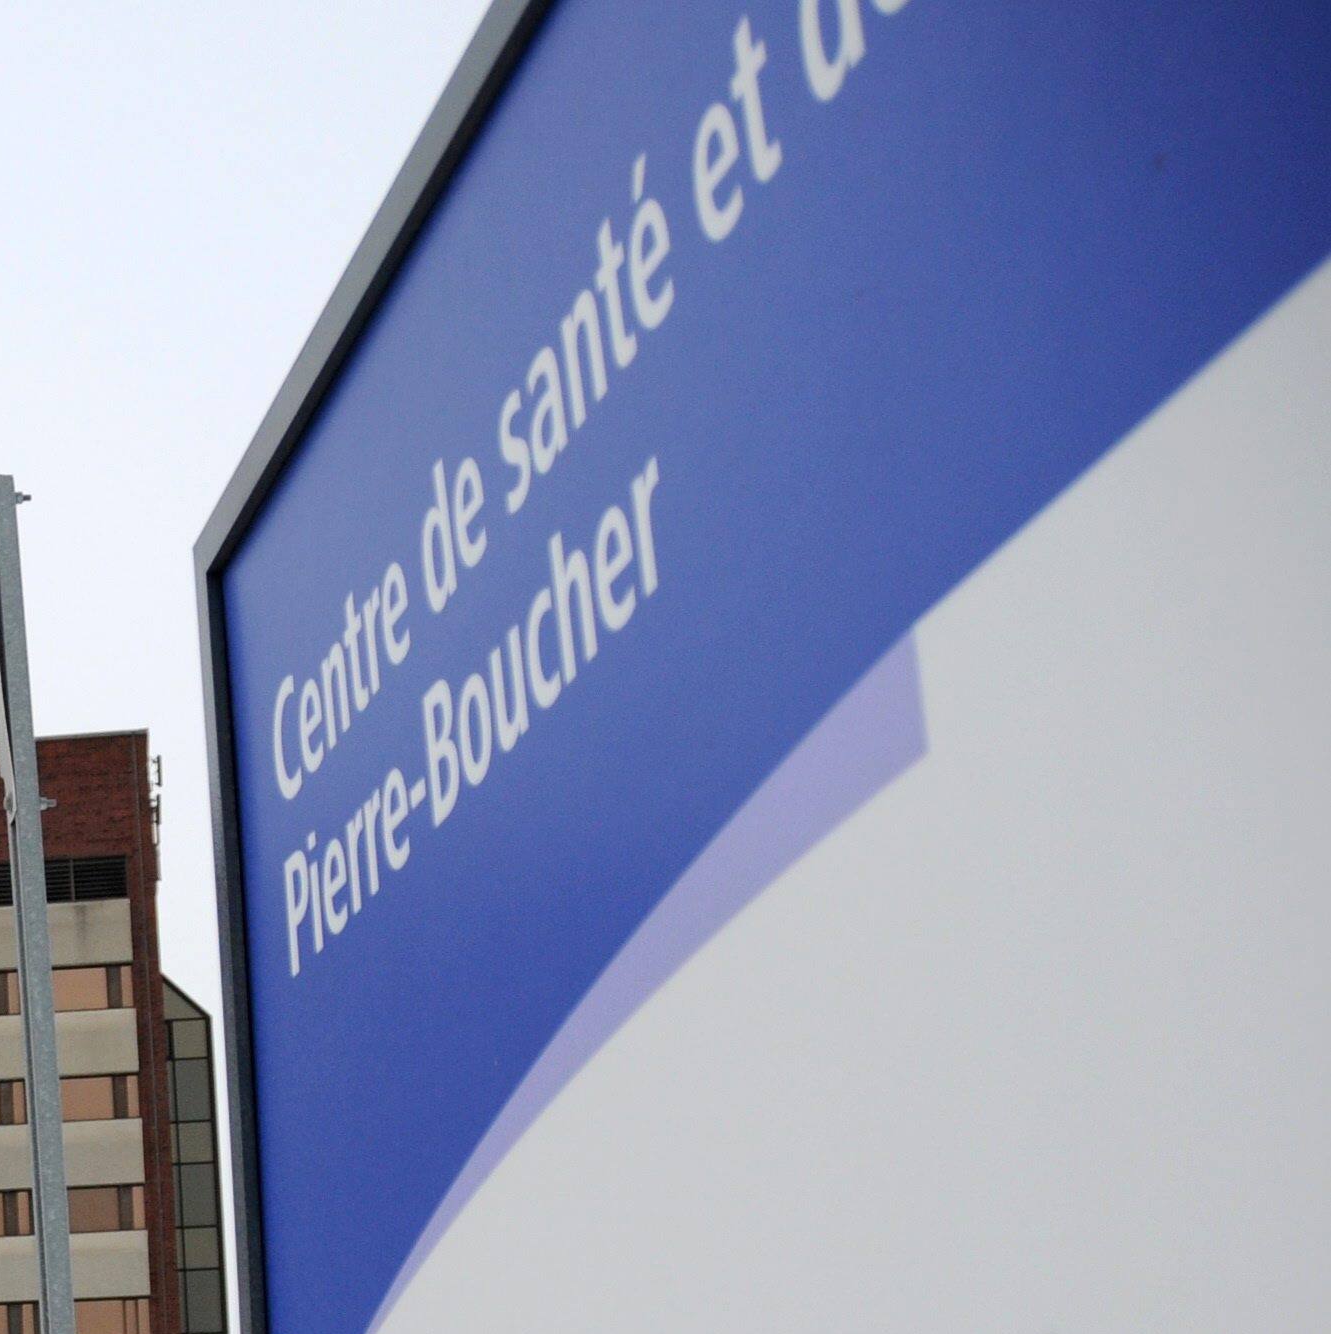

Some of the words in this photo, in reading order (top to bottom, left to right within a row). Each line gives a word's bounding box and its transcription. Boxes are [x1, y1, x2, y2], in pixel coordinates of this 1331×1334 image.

[272, 561, 412, 801] Centre
[420, 457, 488, 614] de
[498, 155, 676, 515] santé
[693, 18, 783, 242] et
[283, 456, 660, 978] Pierre-Boucher
